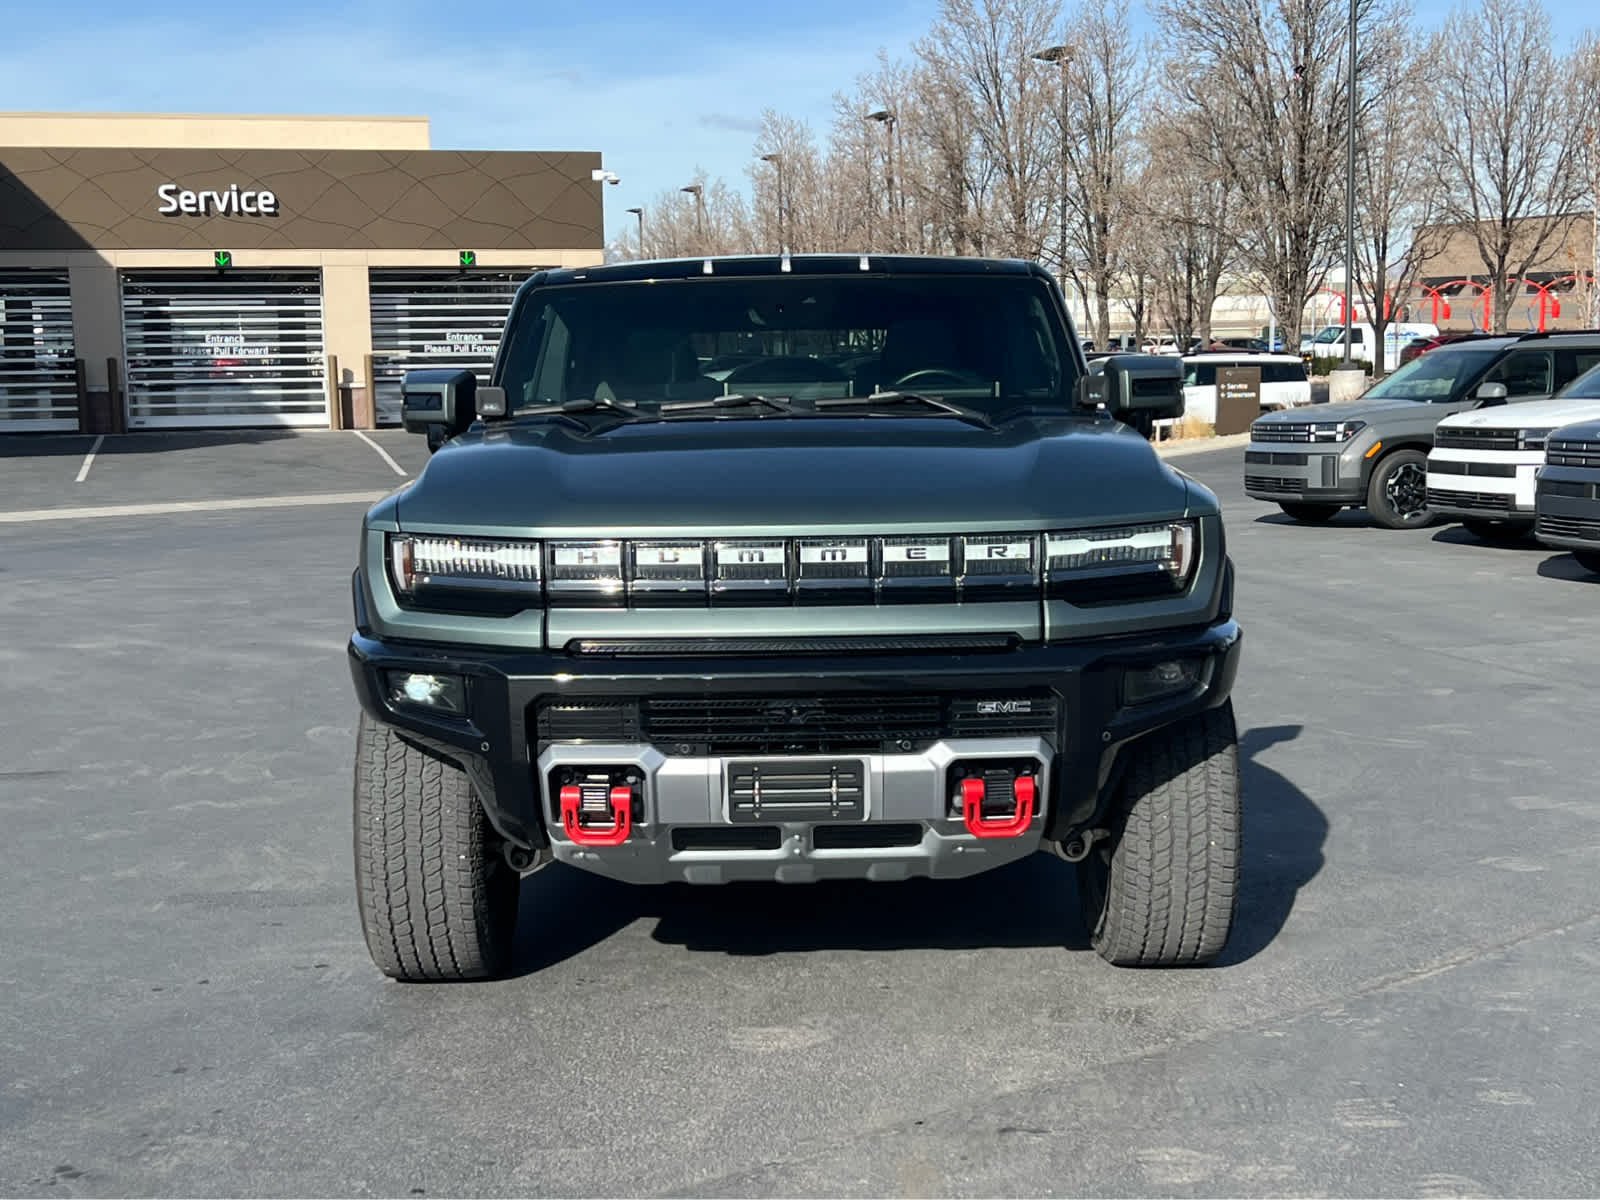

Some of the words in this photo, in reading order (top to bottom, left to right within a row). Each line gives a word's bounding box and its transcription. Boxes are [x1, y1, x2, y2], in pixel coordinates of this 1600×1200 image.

[158, 184, 276, 213] Service
[204, 334, 245, 344] Entrance
[445, 333, 484, 343] Entrance
[182, 346, 212, 356] Please
[213, 346, 231, 356] Pull
[232, 346, 269, 356] Forward
[424, 344, 452, 353] Please
[453, 344, 470, 353] Pull
[471, 344, 500, 353] Forwa
[577, 546, 1009, 564] HUMMER
[976, 701, 1032, 713] GMC
